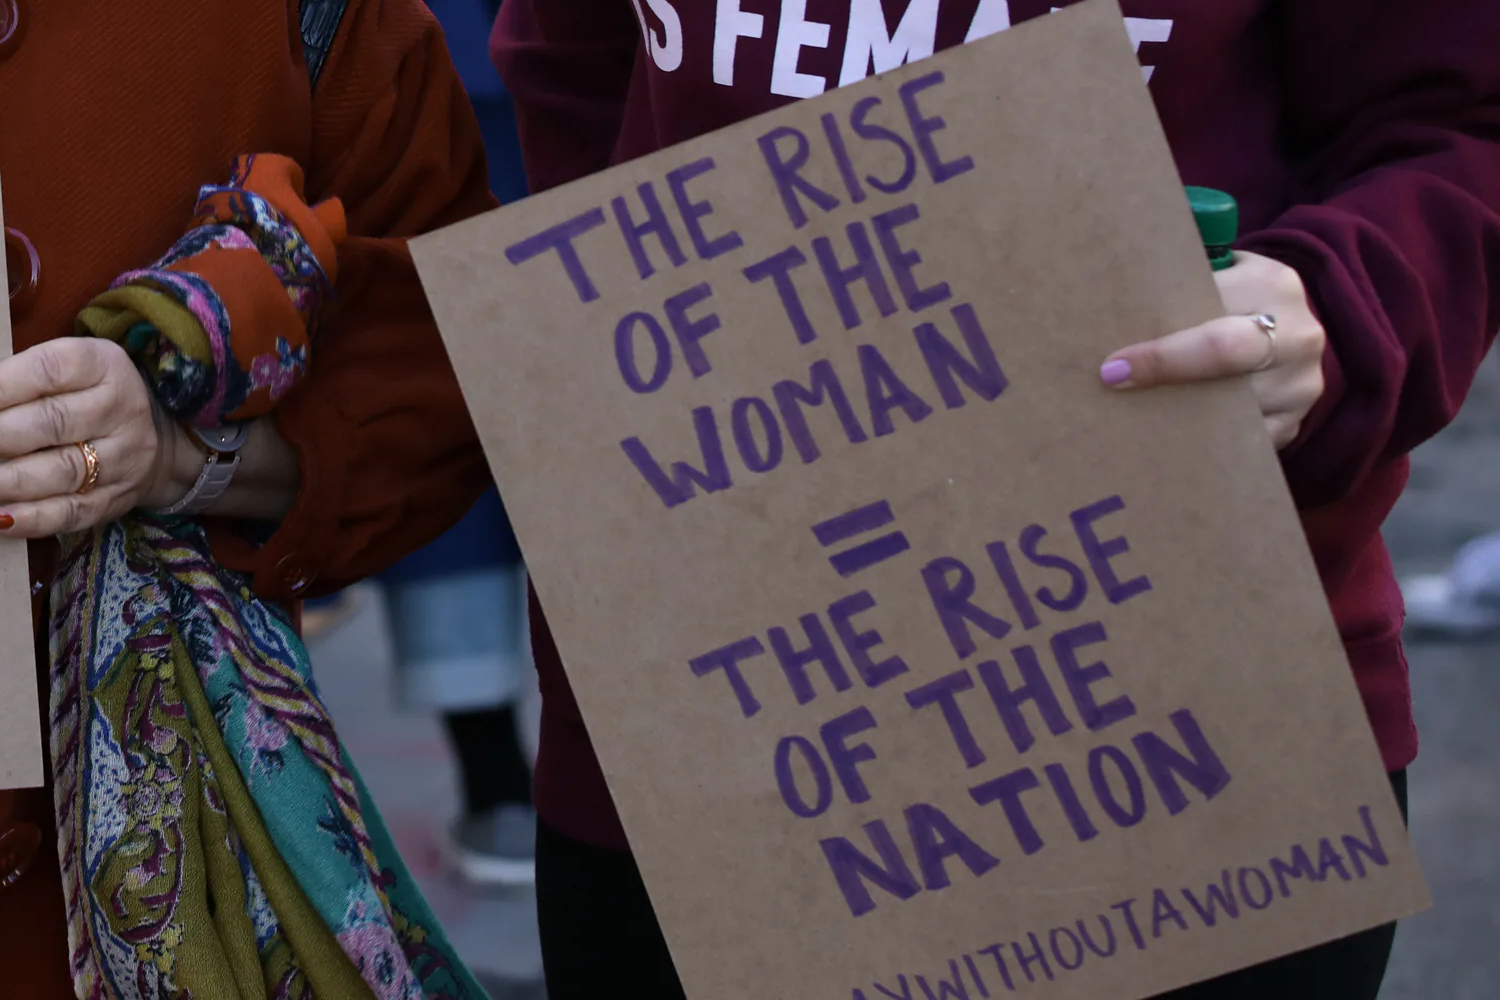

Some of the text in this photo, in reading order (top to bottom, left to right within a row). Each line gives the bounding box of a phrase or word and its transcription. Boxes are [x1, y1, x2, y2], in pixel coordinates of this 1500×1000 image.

[504, 71, 975, 303] THE RISE
[613, 204, 952, 394] OF THE
[620, 303, 1008, 508] WOMAN
[689, 496, 1153, 718] THE RISE
[773, 622, 1136, 819] OF THE
[820, 709, 1232, 917] NATION
